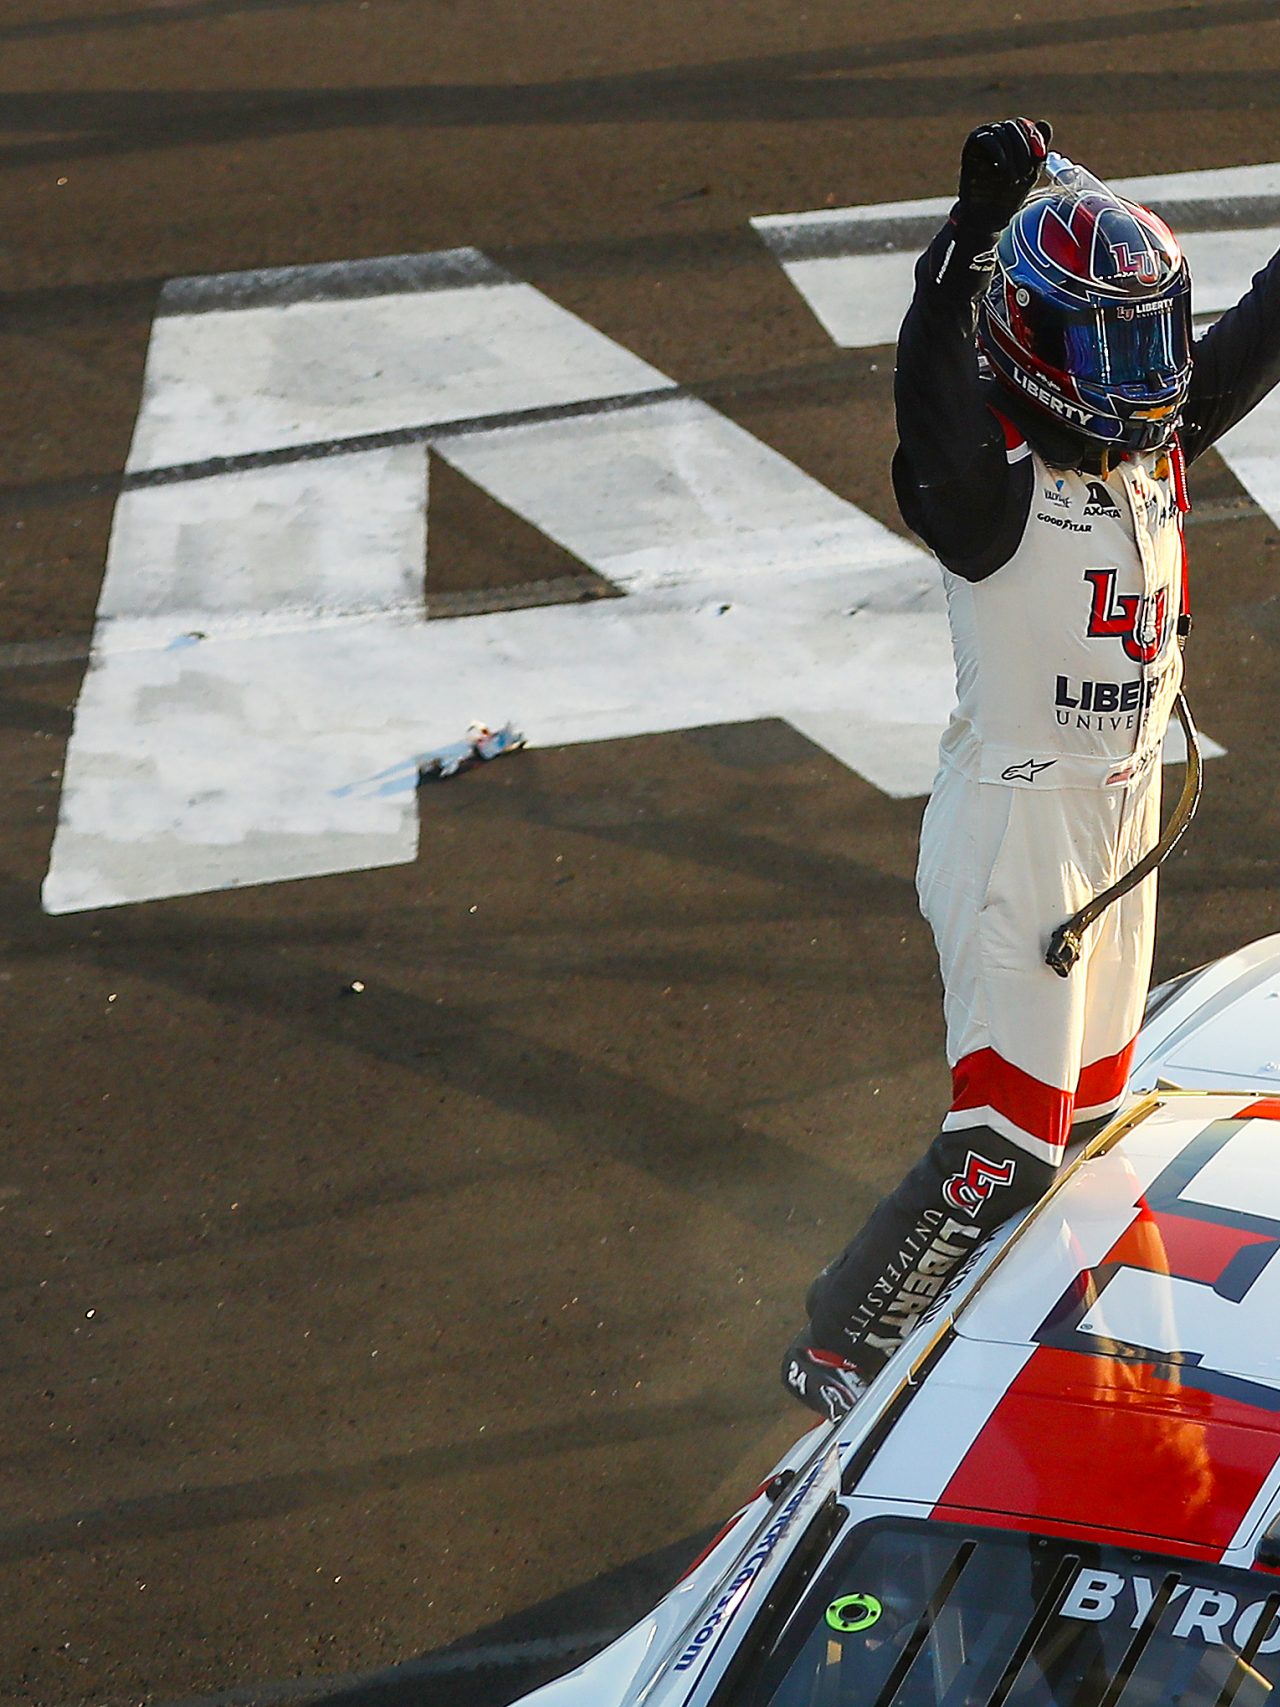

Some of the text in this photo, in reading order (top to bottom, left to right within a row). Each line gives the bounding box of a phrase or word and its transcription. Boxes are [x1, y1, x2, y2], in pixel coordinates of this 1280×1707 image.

[1136, 298, 1174, 314] LIBERTY
[1013, 366, 1093, 426] LIBERTY
[1037, 513, 1092, 532] GOODYEAR
[1083, 568, 1166, 665] LU
[844, 1208, 943, 1344] UNIVERSITY
[864, 1217, 982, 1357] LIBERTY
